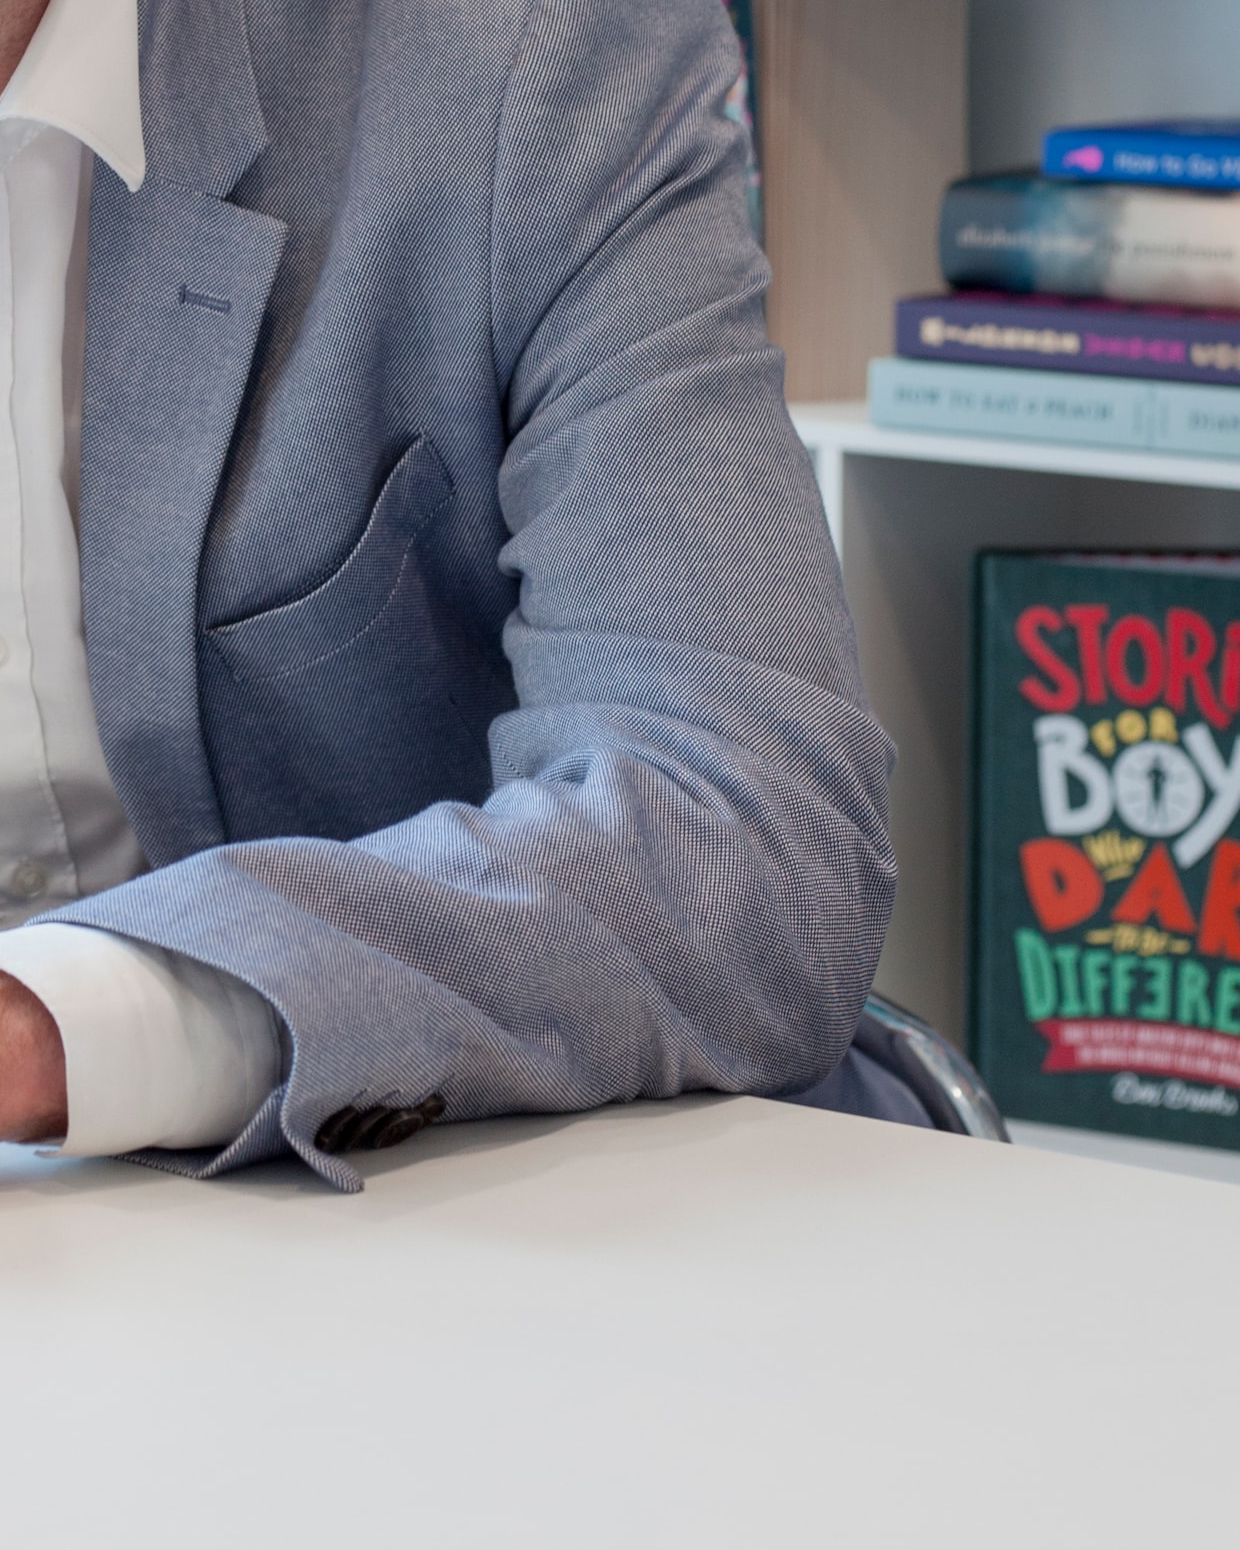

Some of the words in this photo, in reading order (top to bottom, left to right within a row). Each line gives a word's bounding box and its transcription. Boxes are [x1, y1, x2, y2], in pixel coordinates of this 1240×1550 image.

[1114, 151, 1157, 174] How
[1162, 153, 1183, 174] to
[1188, 154, 1217, 178] Go
[894, 386, 940, 404] HOW
[948, 390, 973, 408] TO
[1044, 398, 1113, 420] PEACH
[1091, 707, 1178, 756] FOR
[1033, 714, 1240, 868] BOY
